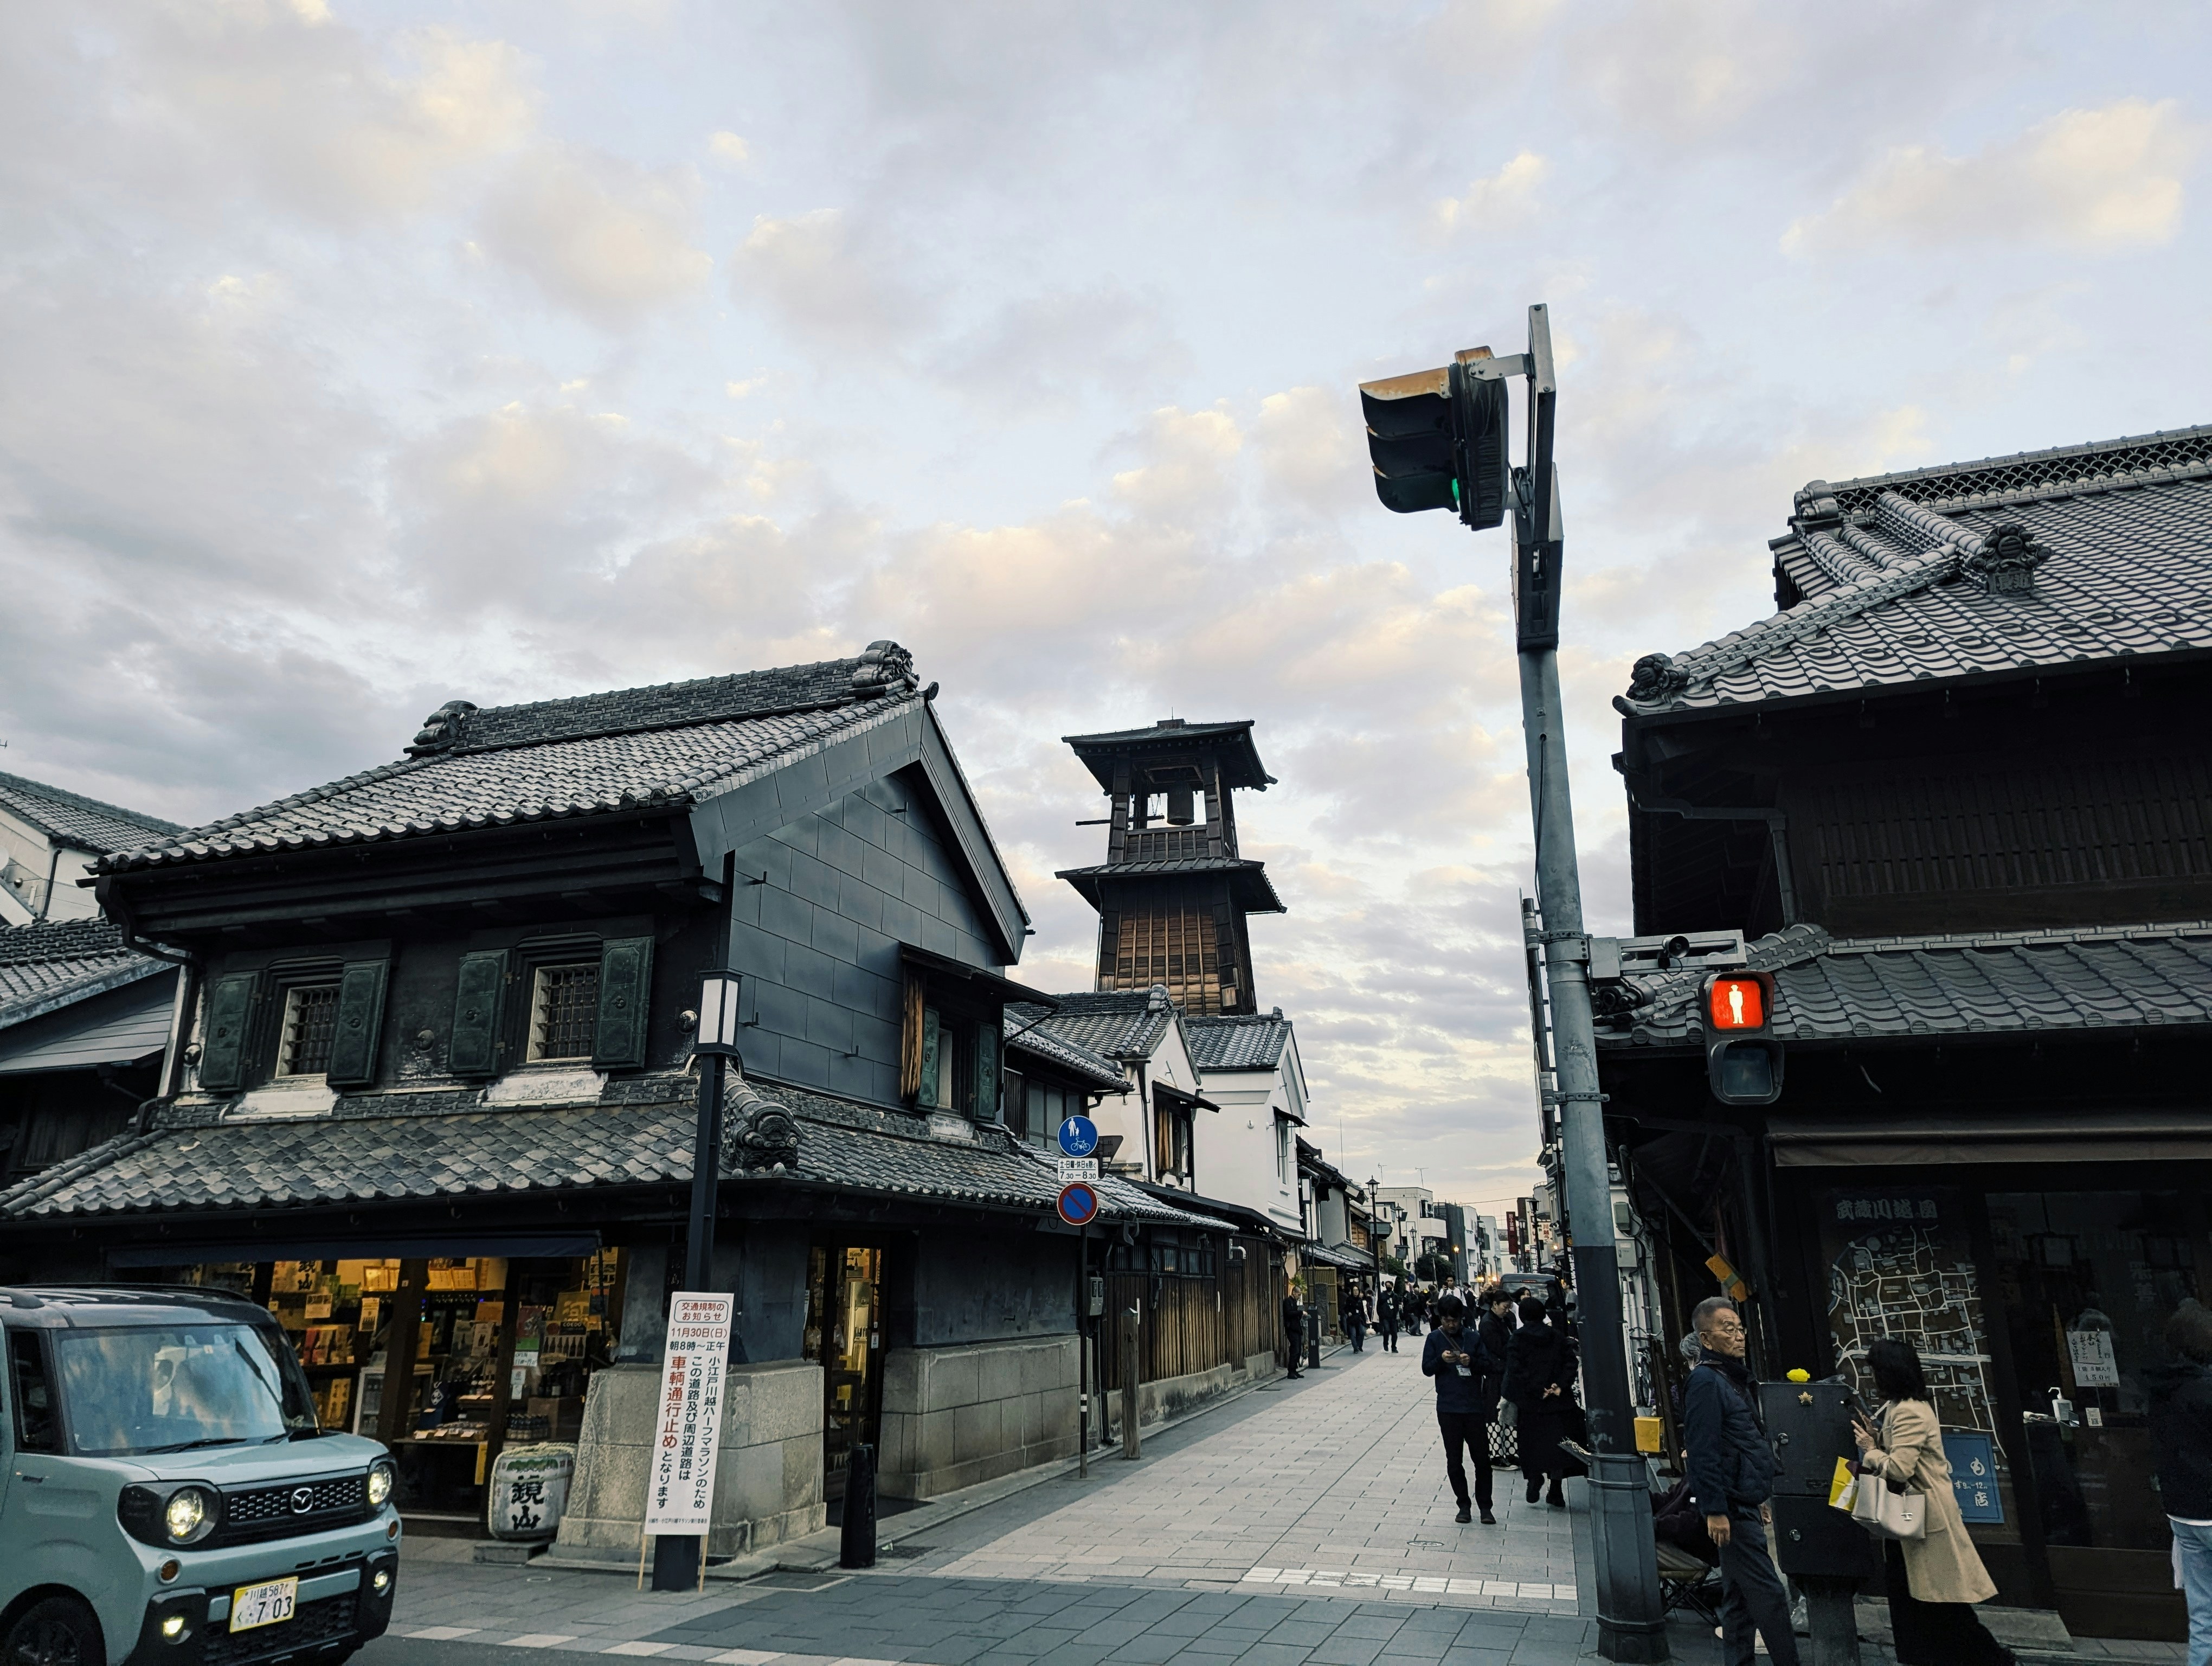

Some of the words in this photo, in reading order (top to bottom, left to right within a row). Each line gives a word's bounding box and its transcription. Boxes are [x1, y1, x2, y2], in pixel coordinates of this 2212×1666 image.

[671, 1328, 728, 1338] 11月30日(日)
[681, 1302, 725, 1311] 交通規制の
[682, 1312, 722, 1321] お知らせ
[656, 1355, 687, 1509] 車輌通行止めとなります
[679, 1356, 702, 1481] この道路及び周辺道路は
[693, 1356, 721, 1509] 小江戸川越ハーフマラソンのため
[511, 1475, 545, 1531] 鏡山
